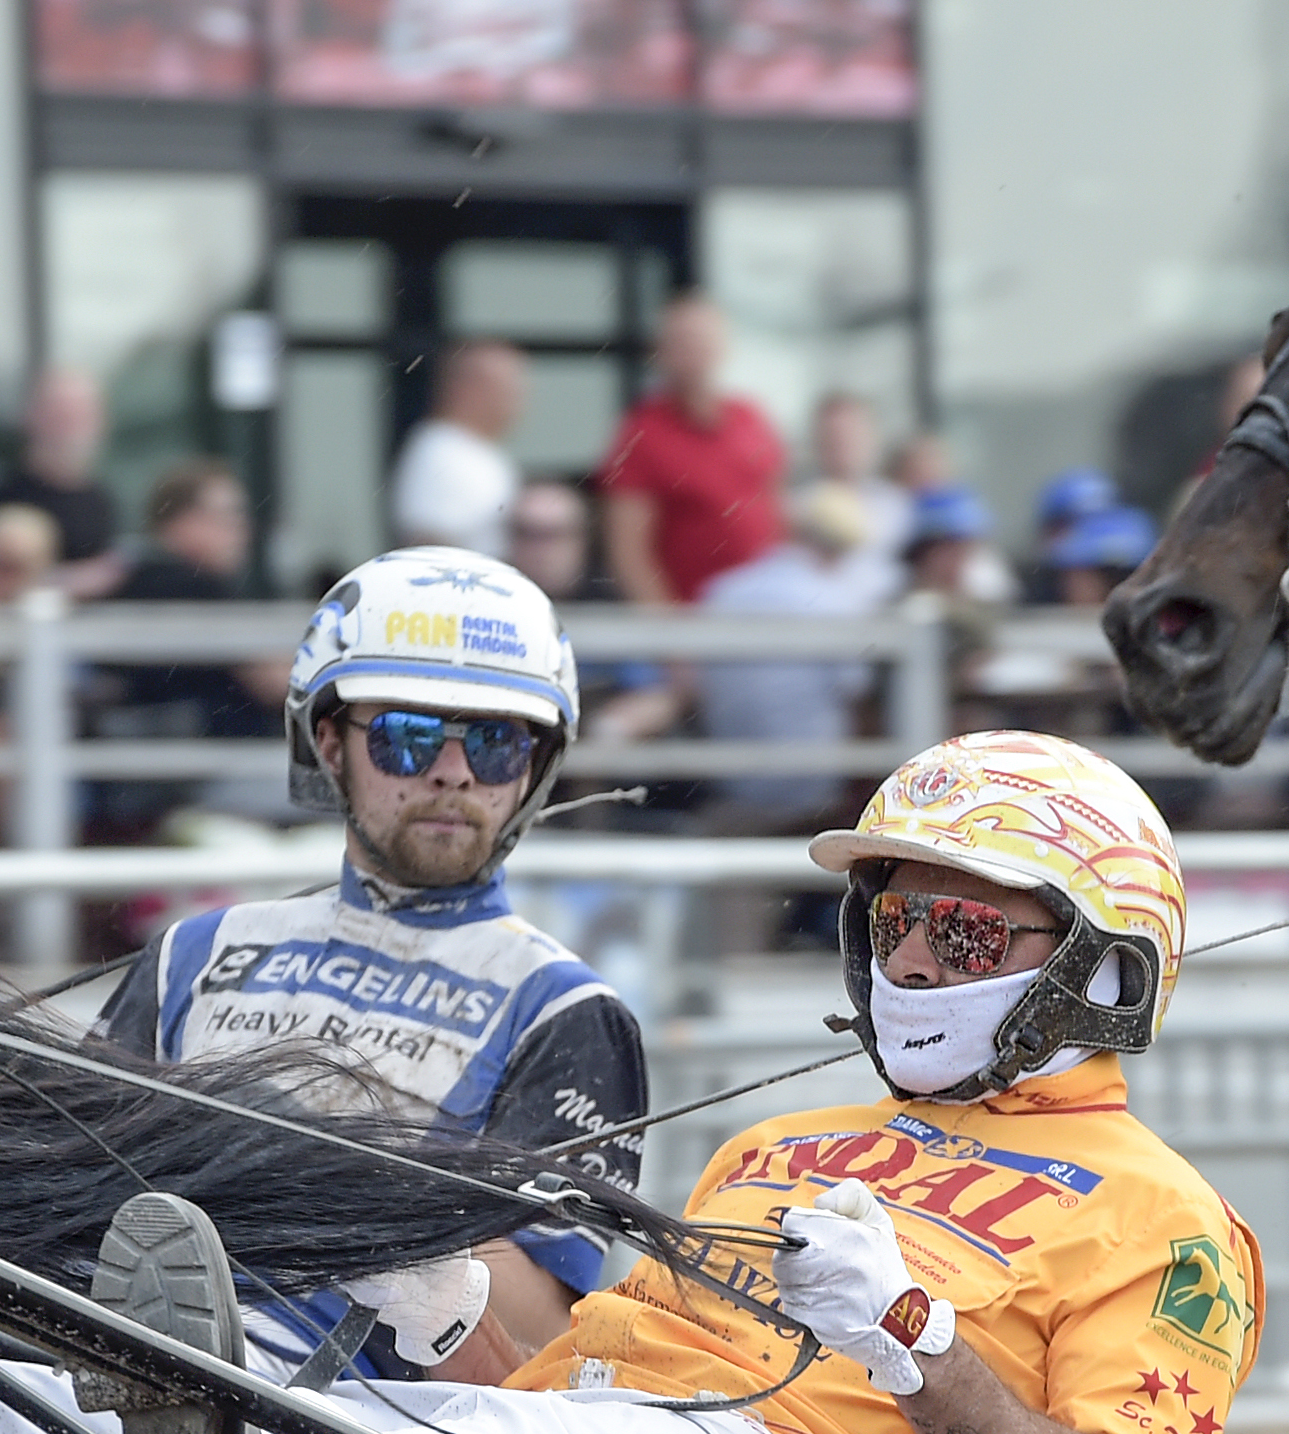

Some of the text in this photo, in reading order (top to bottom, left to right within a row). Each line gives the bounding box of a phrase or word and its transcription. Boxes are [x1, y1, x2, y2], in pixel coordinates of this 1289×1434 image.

[385, 611, 457, 647] PAN
[254, 952, 494, 1024] ENGELINS
[205, 1005, 309, 1036] Heavy
[716, 1129, 1063, 1254] INDAL
[888, 1295, 929, 1340] AG
[1198, 1352, 1212, 1366] IN
